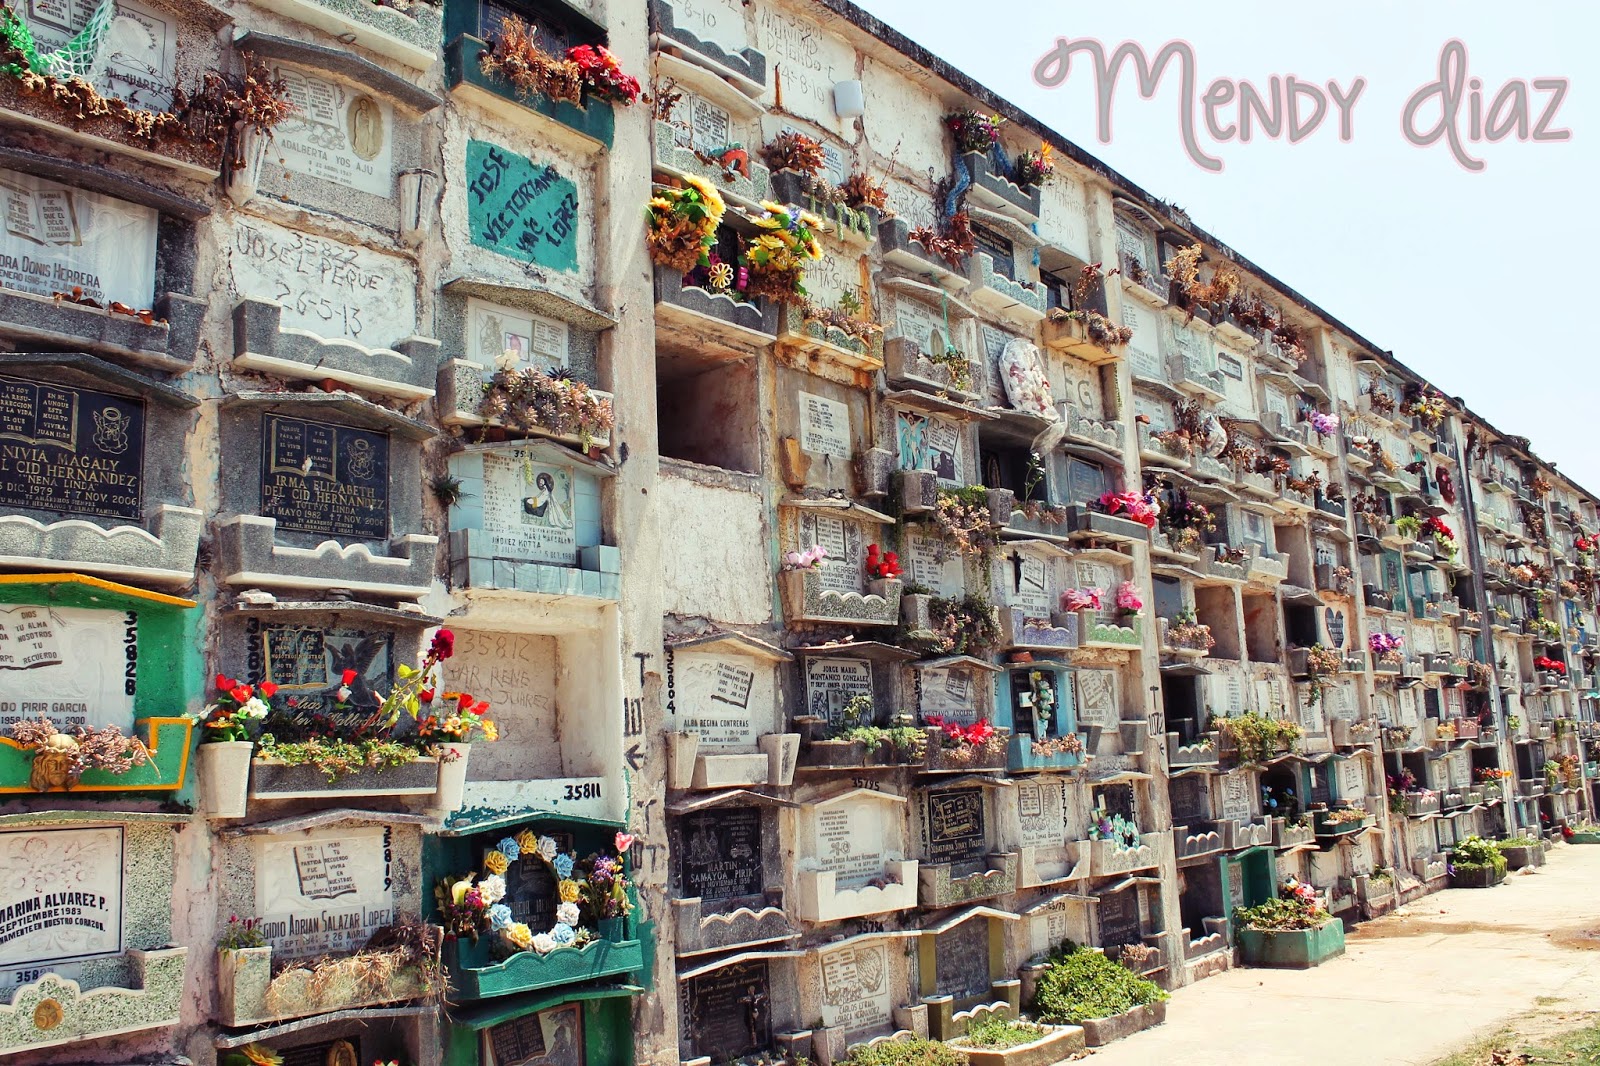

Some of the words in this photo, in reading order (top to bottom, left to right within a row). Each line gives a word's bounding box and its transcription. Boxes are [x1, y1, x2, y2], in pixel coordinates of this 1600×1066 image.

[282, 140, 328, 161] ADALBERTA
[336, 156, 351, 169] YOS
[356, 162, 373, 176] AJU
[470, 146, 511, 206] JOSE
[22, 256, 51, 278] DONIS
[54, 263, 100, 289] HERRERA
[37, 429, 55, 438] JUAN
[2, 446, 49, 463] NIVIA
[57, 452, 120, 472] MAGALY
[16, 460, 41, 475] CID
[47, 464, 137, 487] HERNANDEZ
[30, 486, 53, 495] 1979
[276, 475, 307, 489] IRMA
[314, 480, 375, 498] ELIZABETH
[264, 485, 285, 498] DEL
[292, 488, 310, 501] CID
[316, 491, 385, 510] HERNANDEZ
[278, 508, 302, 517] MAYO
[305, 511, 321, 519] 1982
[834, 566, 860, 575] HERRERA
[21, 611, 37, 619] DIOS
[18, 631, 52, 643] NOSOTROS
[23, 652, 58, 664] RECUERDO
[123, 610, 138, 696] 35828
[840, 666, 857, 674] MARIO
[491, 666, 530, 688] RENE
[842, 674, 869, 682] GONZALEZ
[22, 702, 49, 712] PIRIR
[52, 703, 87, 713] GARCIA
[65, 717, 86, 725] 2000
[720, 720, 749, 728] CONTRERAS
[564, 782, 602, 801] 35811
[708, 862, 738, 872] MARTIN
[691, 872, 728, 883] SAMAYOA
[735, 868, 753, 878] PIRIR
[44, 892, 97, 908] ALVAREZ
[100, 896, 109, 912] P.
[0, 908, 59, 935] SEPTIEMBRE
[61, 908, 82, 916] 1983
[34, 922, 42, 931] EN
[44, 918, 73, 928] NUESTRO
[290, 914, 319, 936] ADRIAN
[322, 910, 360, 932] SALAZAR
[363, 906, 391, 927] LOPEZ
[839, 1003, 858, 1014] CARLOS
